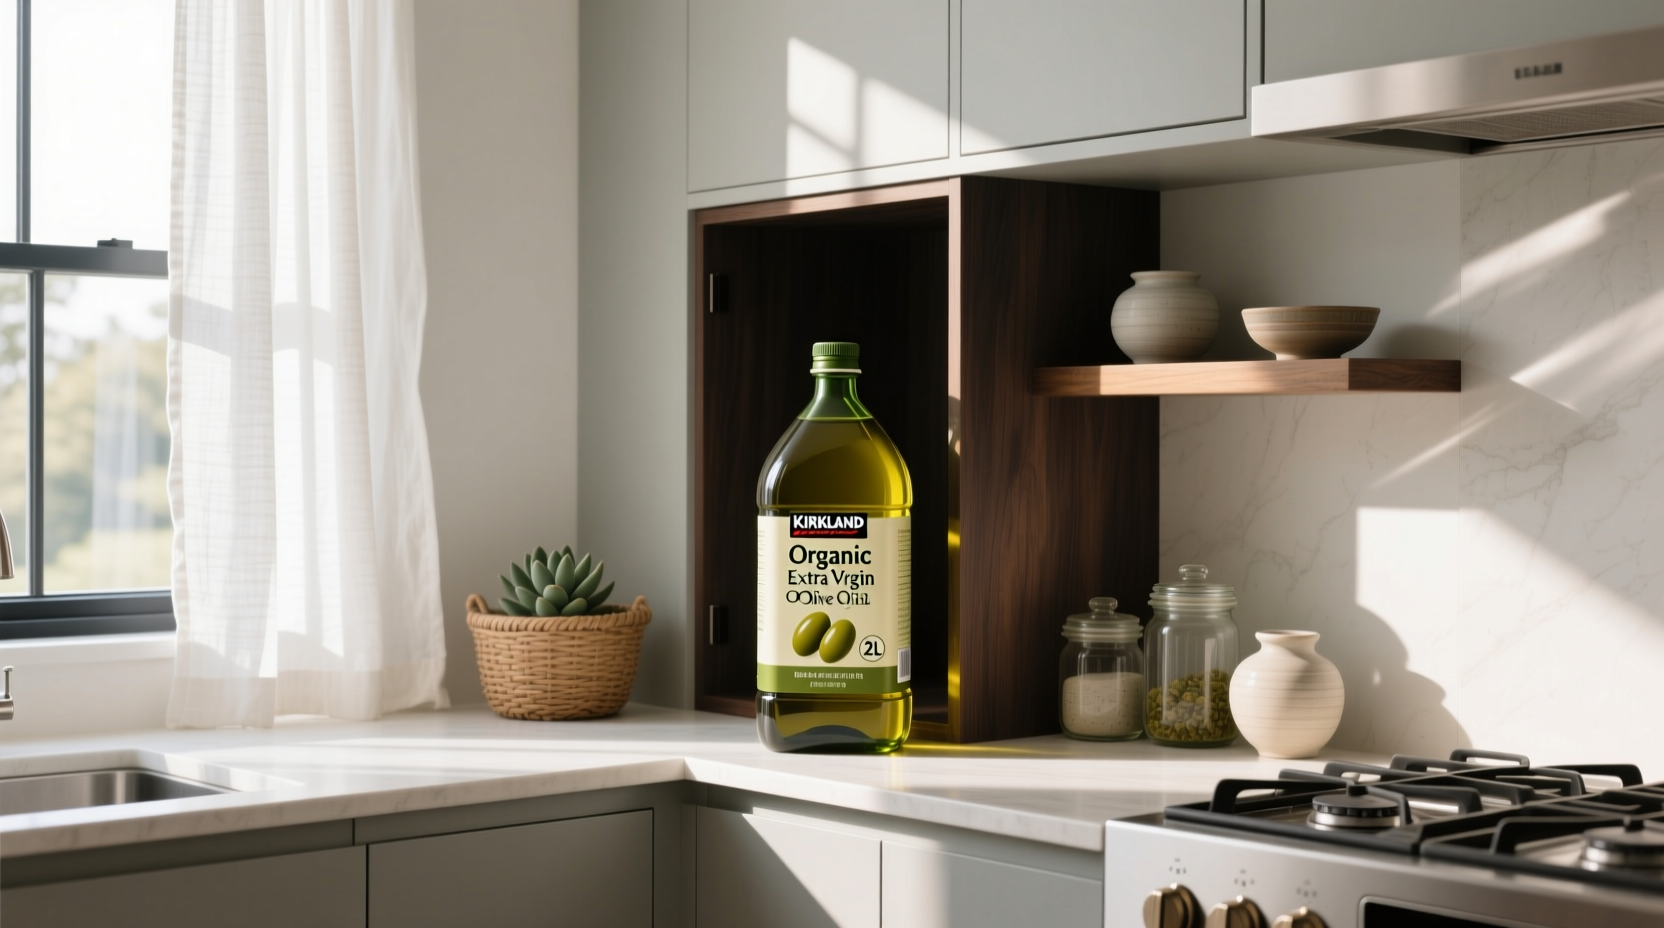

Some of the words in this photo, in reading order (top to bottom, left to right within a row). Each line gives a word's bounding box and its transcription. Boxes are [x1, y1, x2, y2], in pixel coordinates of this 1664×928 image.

[793, 515, 864, 529] KIRKLAND
[789, 544, 872, 570] Organic
[788, 569, 828, 585] Extra
[831, 569, 875, 590] Vrgin
[863, 640, 882, 656] 2L
